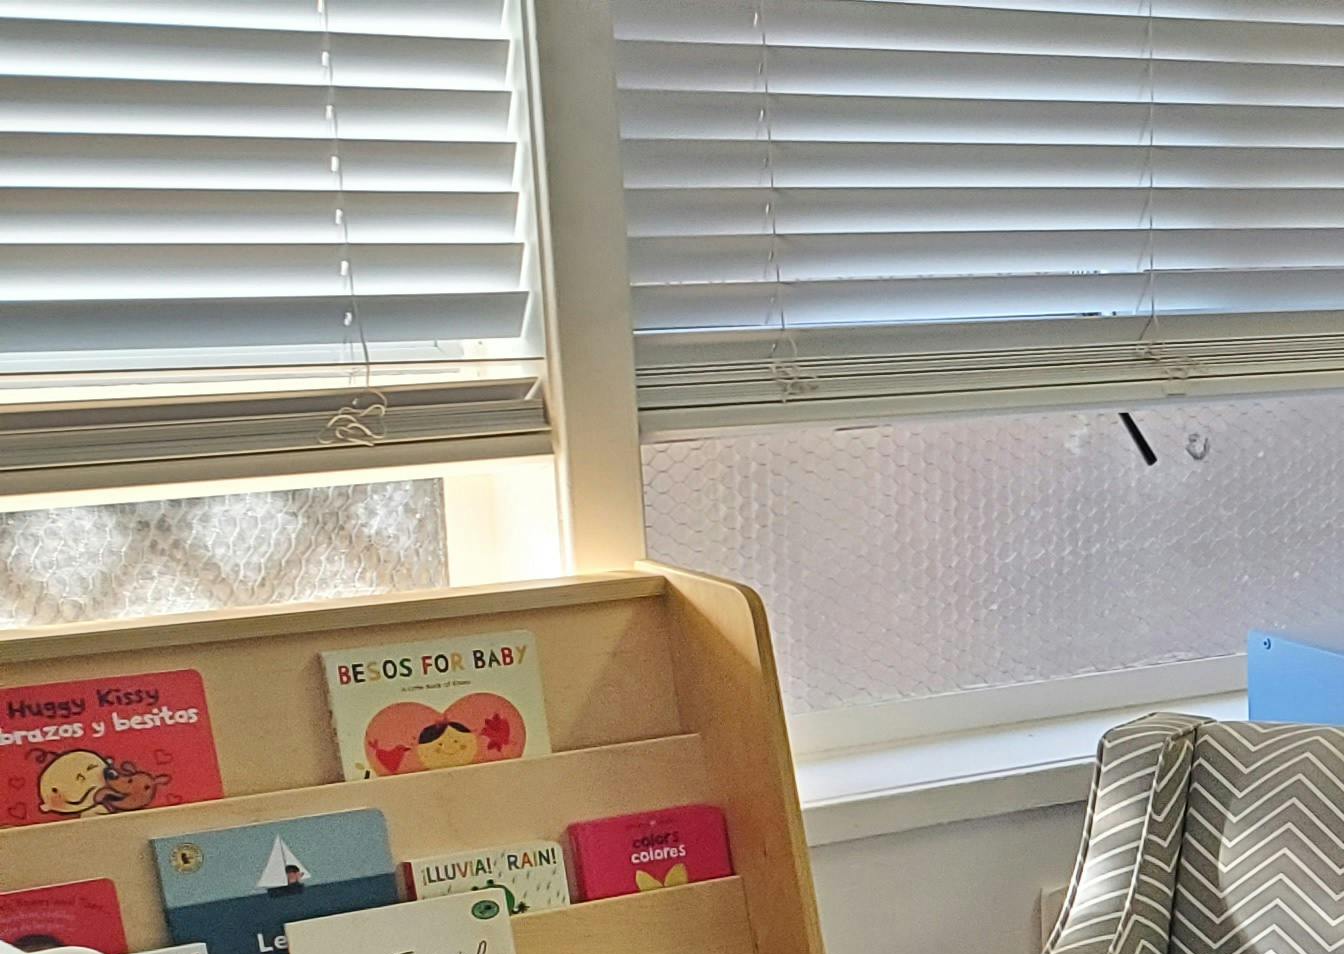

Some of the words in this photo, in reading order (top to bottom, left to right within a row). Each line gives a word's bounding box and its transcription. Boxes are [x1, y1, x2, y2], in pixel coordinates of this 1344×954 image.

[337, 658, 413, 685] BESOS
[421, 652, 465, 675] FOR
[473, 645, 527, 669] BABY
[7, 697, 86, 719] Huggy
[96, 688, 160, 708] Kissy
[91, 720, 105, 738] y
[112, 705, 199, 732] besitos
[632, 831, 680, 849] colors
[506, 847, 558, 871] RAIN!
[631, 844, 687, 864] colores
